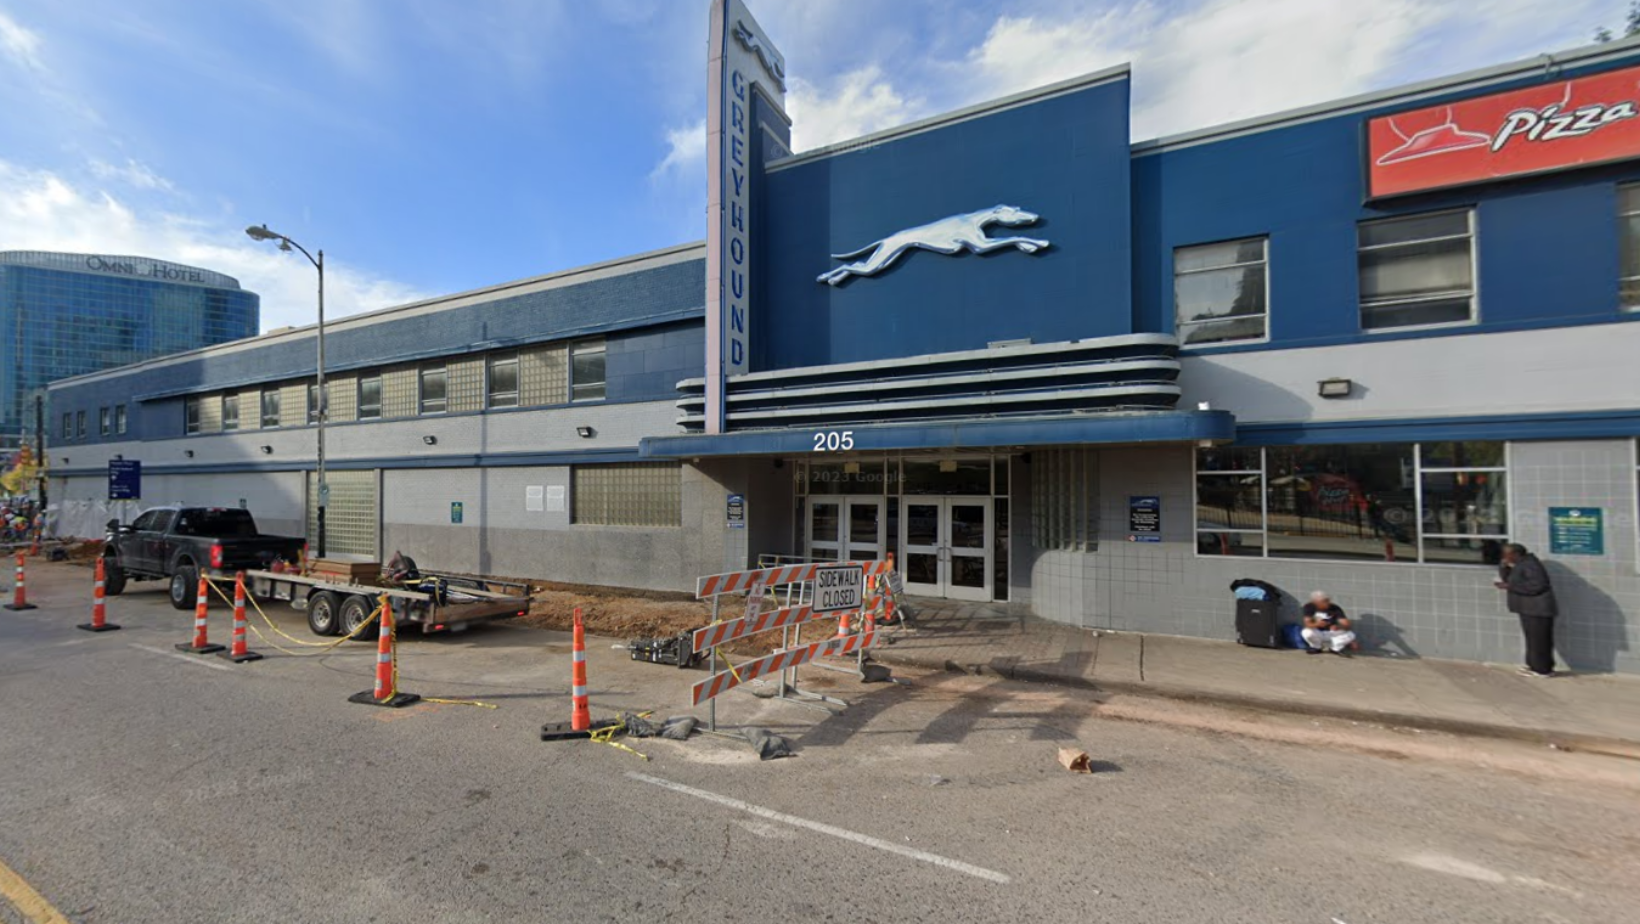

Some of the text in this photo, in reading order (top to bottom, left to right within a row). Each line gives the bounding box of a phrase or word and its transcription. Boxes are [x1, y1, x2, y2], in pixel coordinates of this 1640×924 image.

[1489, 101, 1638, 153] Pizza
[731, 68, 745, 366] GREYHOUND
[813, 431, 854, 452] 205
[818, 570, 860, 588] SIDEWALK
[822, 588, 856, 608] CLOSED
